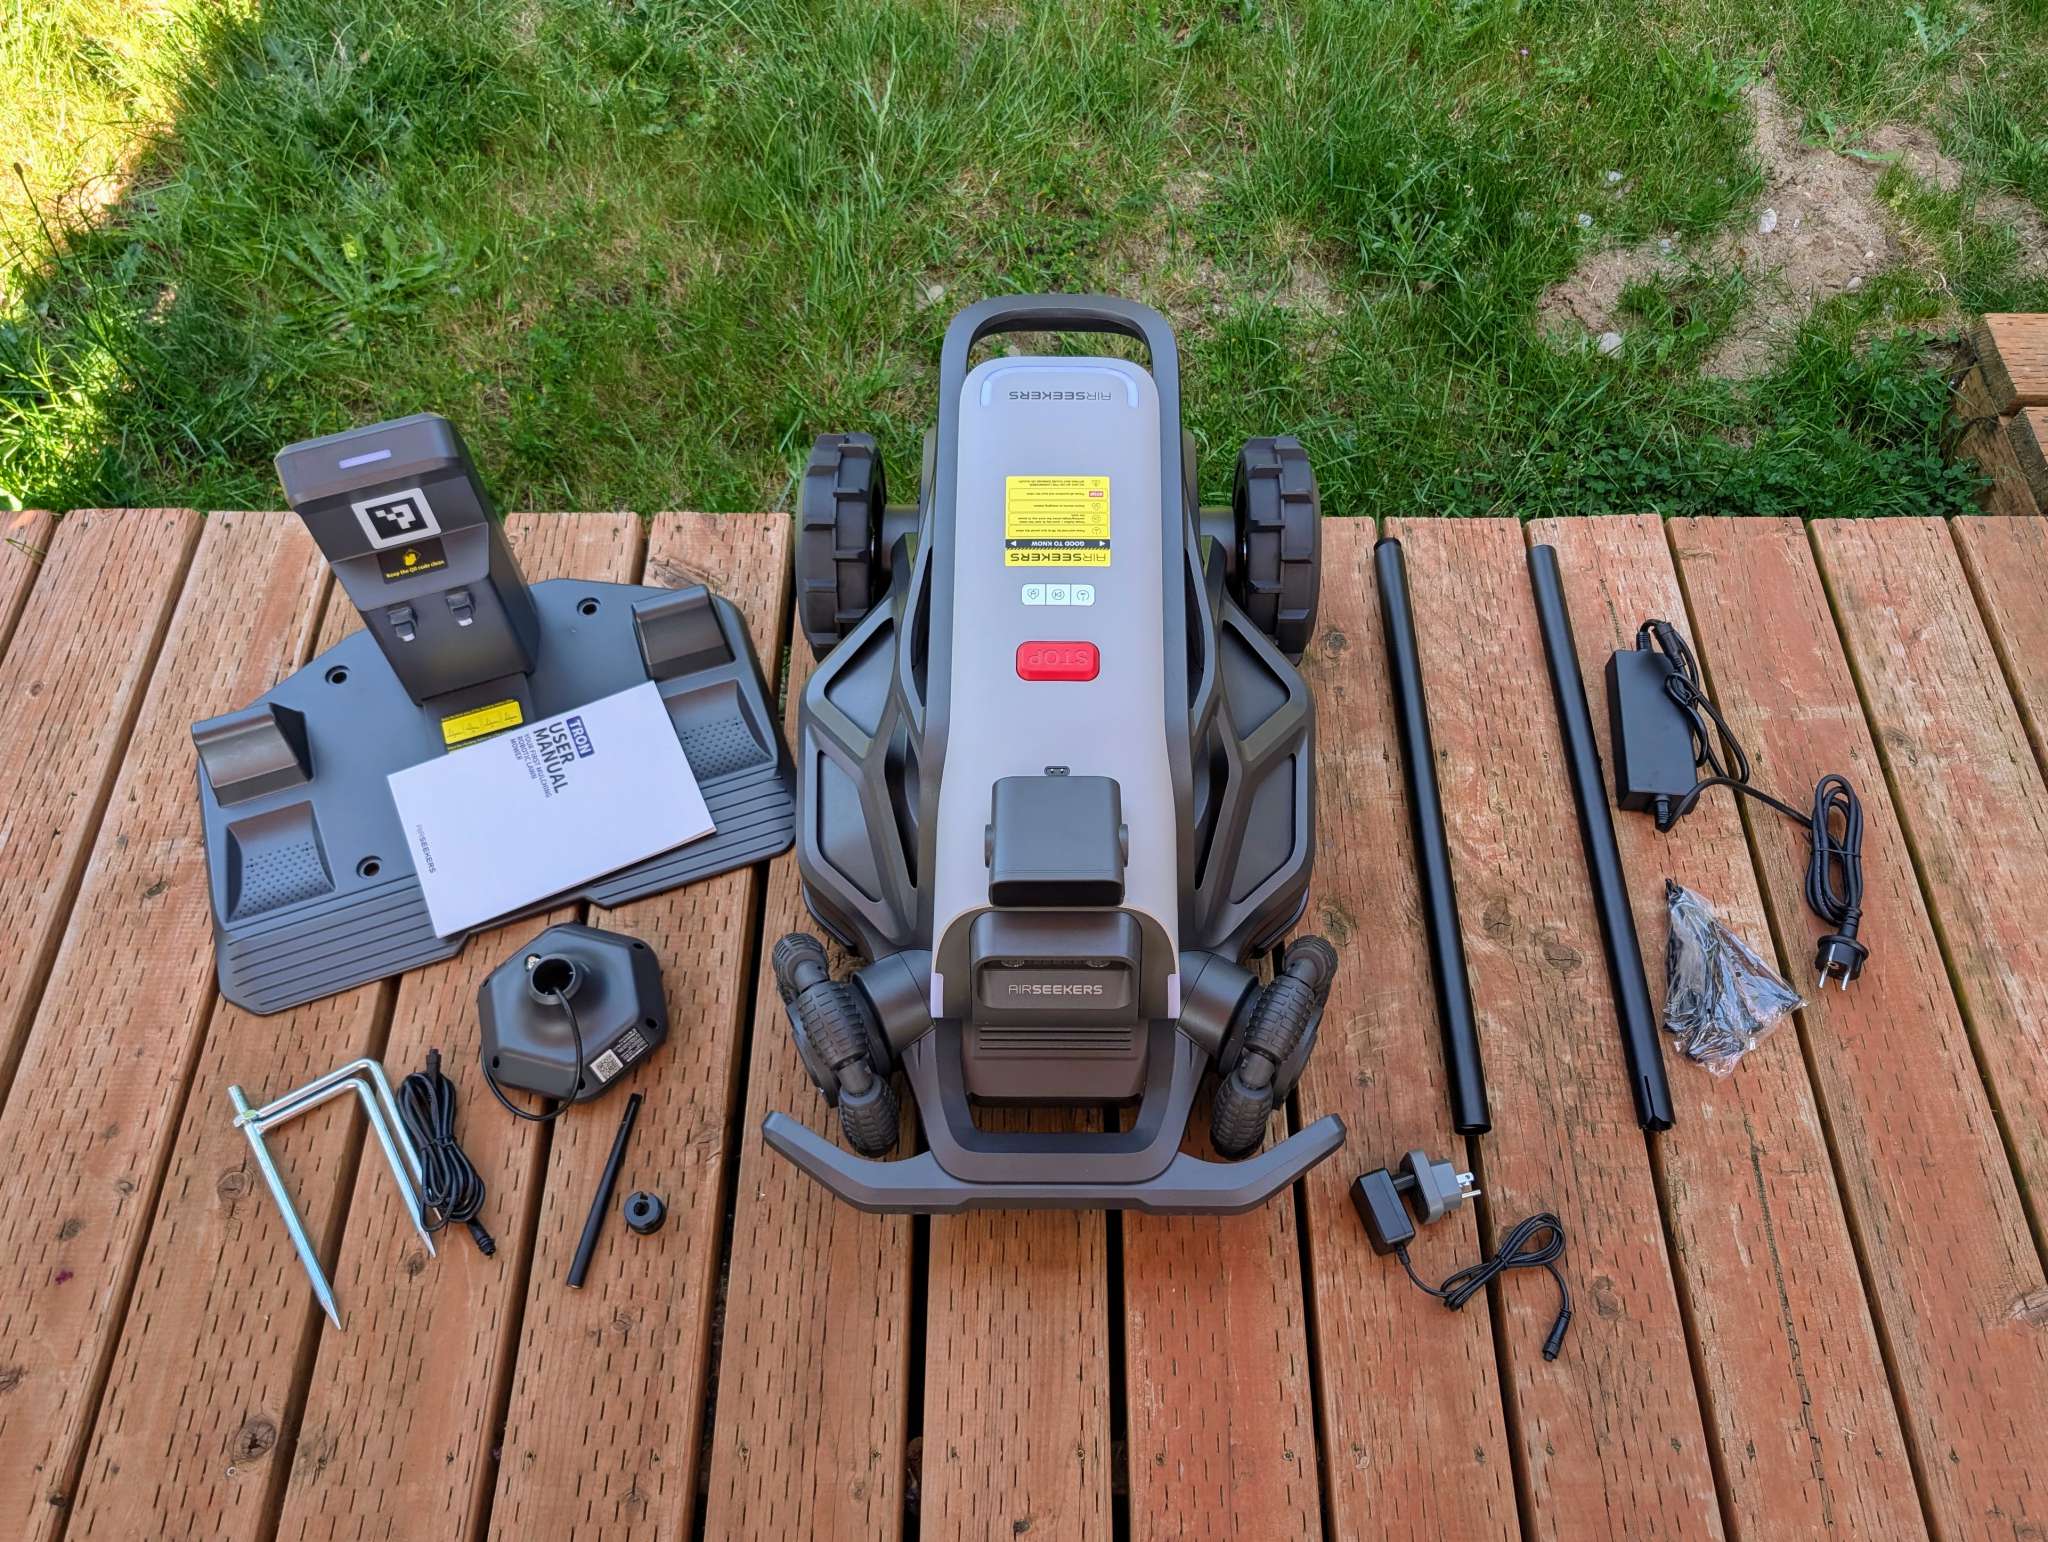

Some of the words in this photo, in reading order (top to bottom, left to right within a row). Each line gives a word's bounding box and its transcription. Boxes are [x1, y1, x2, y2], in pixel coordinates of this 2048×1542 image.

[1008, 391, 1112, 400] AIRSEEKERS
[1010, 552, 1106, 561] AIRSEEKERS
[1028, 649, 1088, 665] STOP
[510, 738, 522, 760] MOWER
[524, 734, 534, 749] YOUR
[530, 749, 540, 766] FIRST
[549, 721, 575, 765] USER
[570, 719, 591, 754] TRON
[517, 736, 530, 761] ROBOTIC
[526, 762, 537, 779] LAWN
[533, 727, 568, 793] MANUAL
[1008, 984, 1103, 995] AIRSEEKERS
